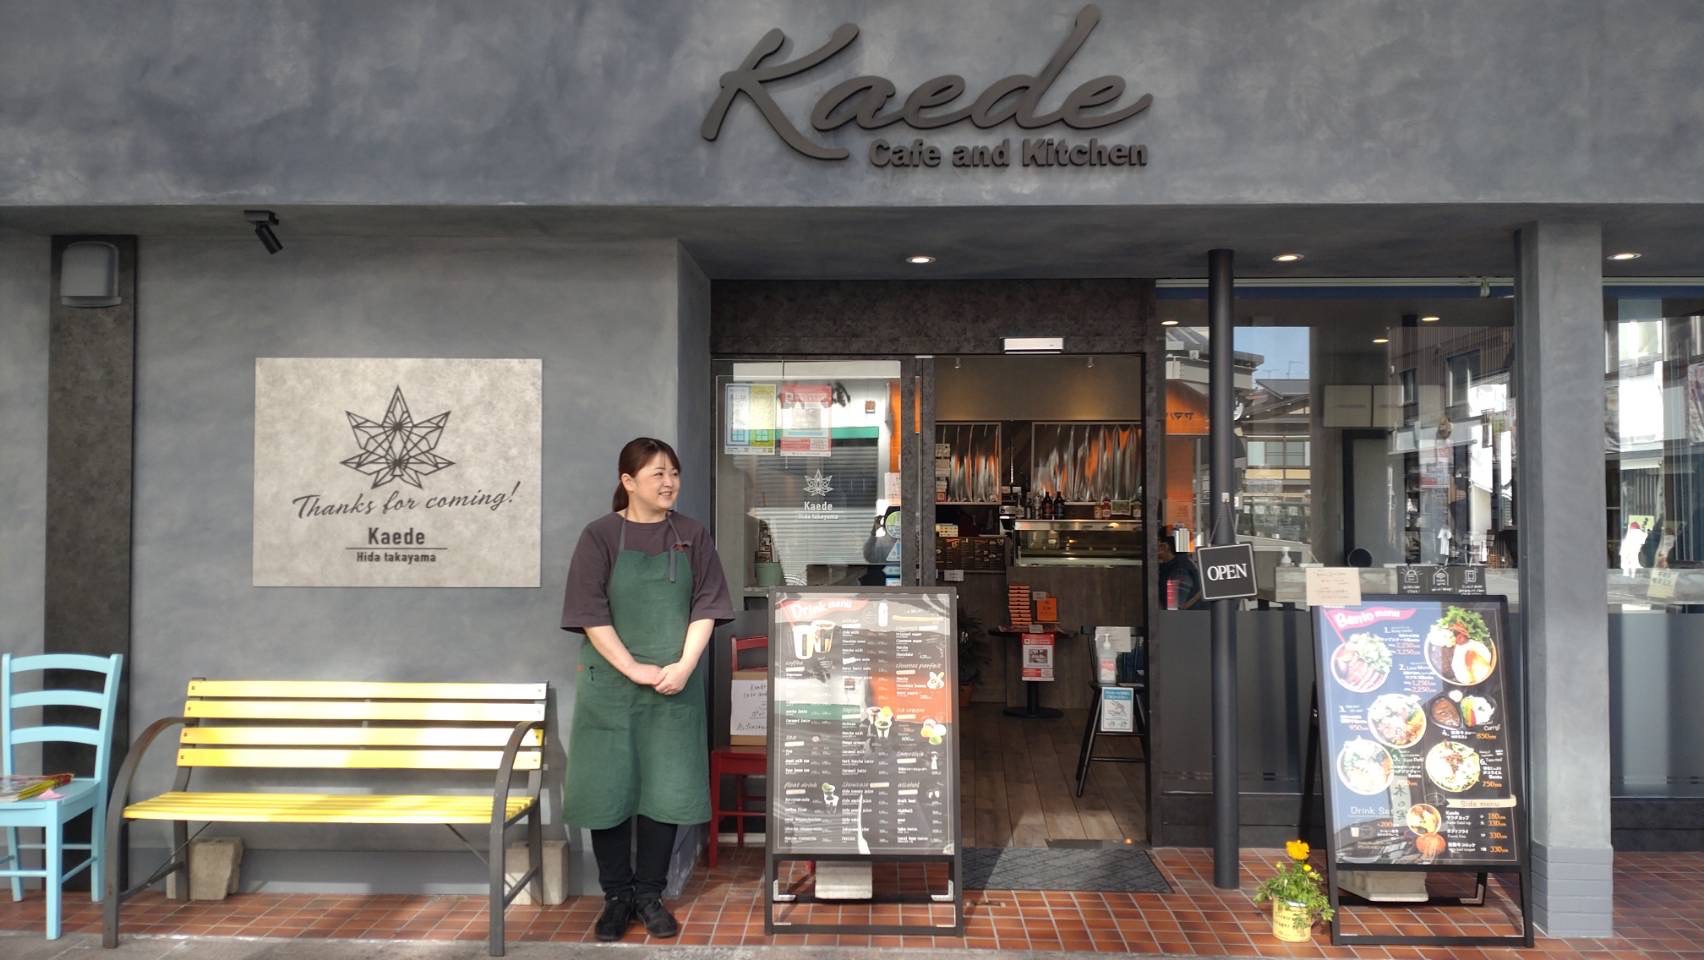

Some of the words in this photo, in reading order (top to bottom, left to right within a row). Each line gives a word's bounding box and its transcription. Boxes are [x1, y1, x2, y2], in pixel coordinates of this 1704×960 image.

[701, 3, 1154, 160] Kaede
[869, 138, 942, 168] Cafe
[952, 139, 1010, 168] and
[1021, 139, 1148, 168] Kitchen
[292, 493, 376, 519] Thanks
[382, 490, 419, 515] for
[425, 480, 521, 512] coming!
[804, 501, 834, 512] Kaede
[367, 527, 426, 545] Kaede
[356, 552, 380, 563] Hida
[384, 552, 437, 565] takayama
[1207, 563, 1248, 582] OPEN
[1334, 611, 1375, 629] Bento
[1375, 609, 1401, 618] menu
[1350, 806, 1376, 815] Drink
